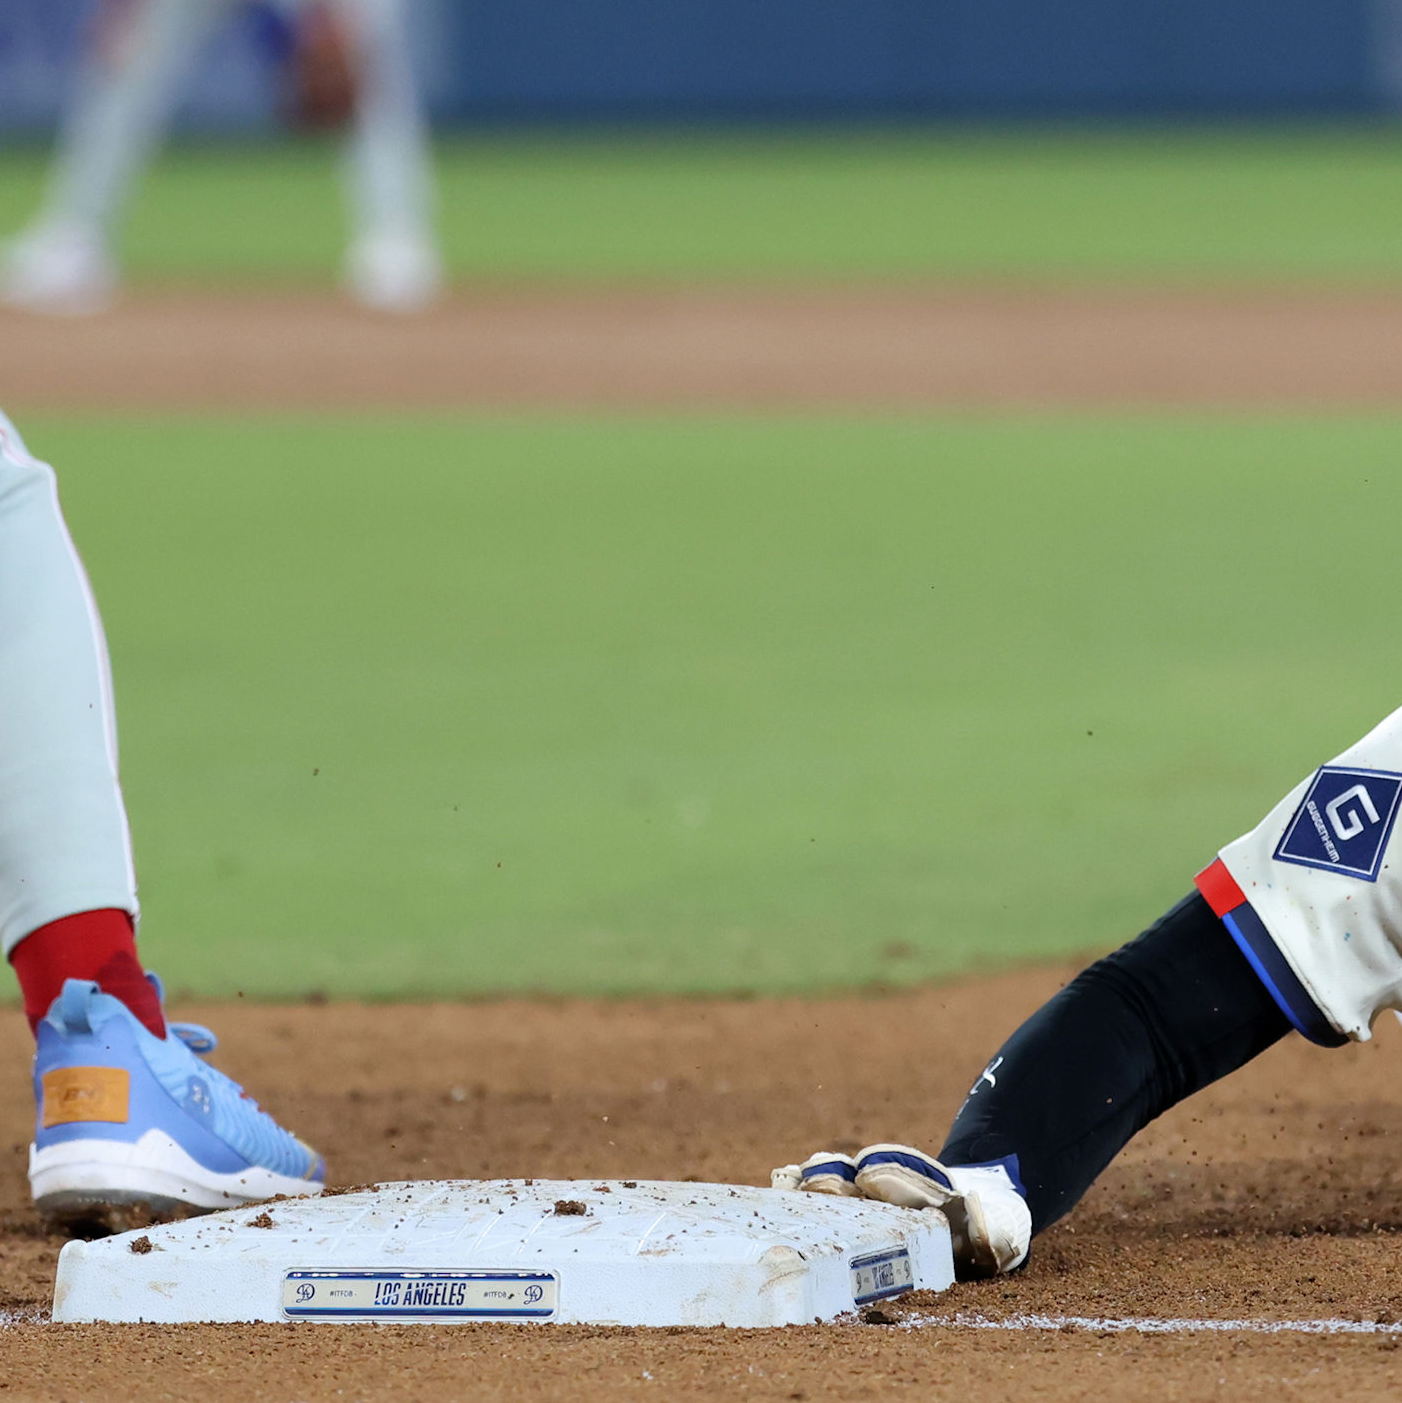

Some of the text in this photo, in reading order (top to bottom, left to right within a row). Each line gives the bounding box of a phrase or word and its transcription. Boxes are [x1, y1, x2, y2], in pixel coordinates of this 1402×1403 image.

[1326, 784, 1380, 840] G
[374, 1282, 401, 1306] LOS
[402, 1282, 467, 1306] ANGELES
